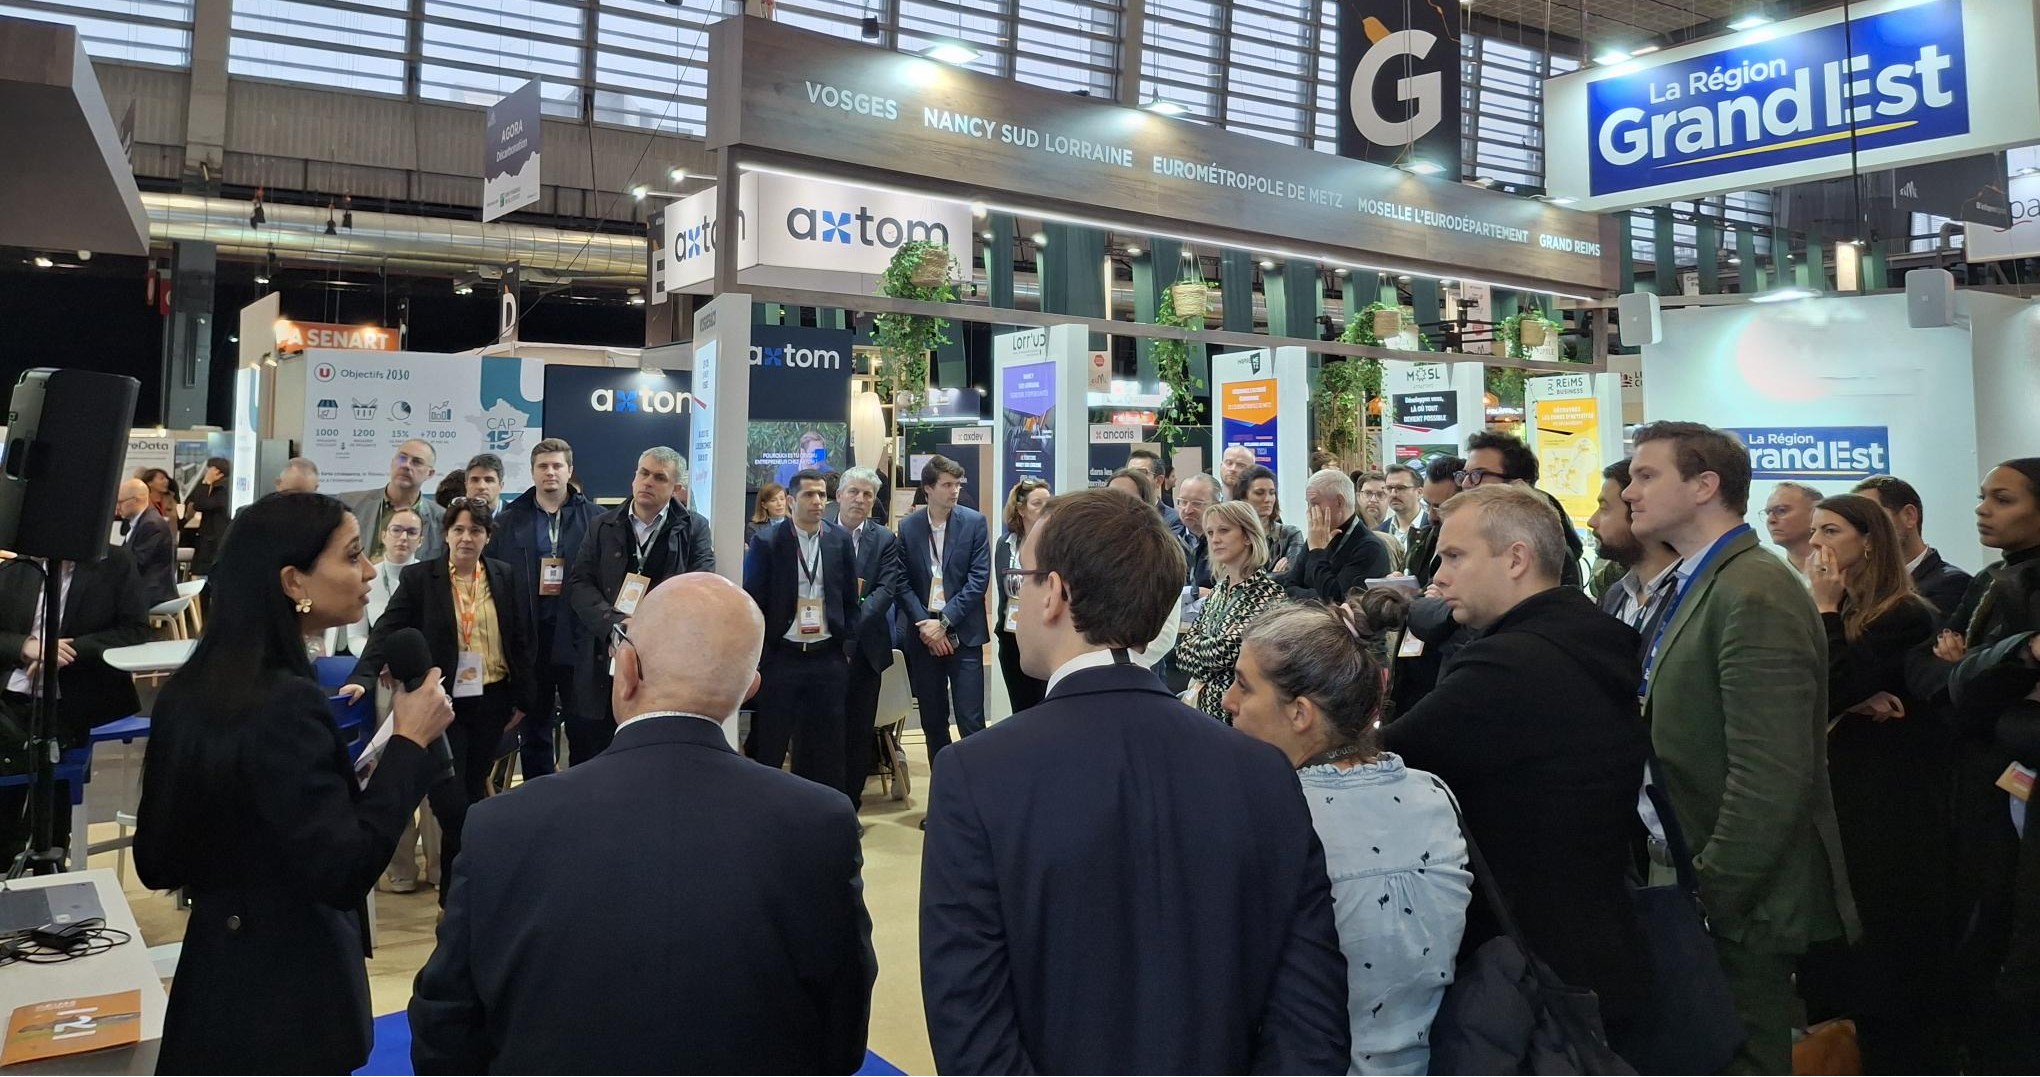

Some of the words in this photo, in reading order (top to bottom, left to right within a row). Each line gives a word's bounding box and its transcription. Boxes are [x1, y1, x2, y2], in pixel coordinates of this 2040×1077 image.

[1350, 29, 1442, 147] G
[1650, 82, 1681, 104] La
[1688, 57, 1788, 97] Région
[1599, 67, 1813, 166] Grand
[1823, 44, 1953, 127] Est
[501, 118, 523, 143] AGORA
[496, 138, 528, 162] Décarbonation
[805, 81, 898, 120] VOSGES
[923, 107, 997, 139] NANCY
[1001, 124, 1040, 148] SUD
[1045, 133, 1133, 168] LORRAINE
[1153, 156, 1284, 197] EUROMÉTROPOLE
[1287, 183, 1305, 200] DE
[1309, 187, 1343, 208] METZ
[1357, 197, 1412, 221] MOSELLE
[1414, 208, 1529, 243] L'EURODÉPARTEMENT
[1539, 233, 1573, 252] GRAND
[1574, 240, 1600, 257] REIMS
[786, 205, 950, 249] axtom
[502, 292, 517, 338] D
[307, 329, 390, 350] SENART
[749, 343, 841, 370] axtom
[319, 367, 331, 379] U
[340, 368, 384, 380] Objectifs
[386, 369, 410, 381] 2030
[1556, 387, 1583, 395] BUSINESS
[315, 428, 339, 437] 1000
[352, 428, 375, 437] 1200
[391, 430, 409, 438] 15%
[420, 431, 437, 439] +70
[439, 431, 457, 439] 000
[486, 417, 517, 430] CAP
[963, 430, 983, 441] axdev
[1103, 427, 1135, 440] ancoris
[1749, 433, 1765, 445] La
[1768, 433, 1815, 446] Région
[1750, 441, 1826, 470] rand
[1829, 441, 1884, 470] Est
